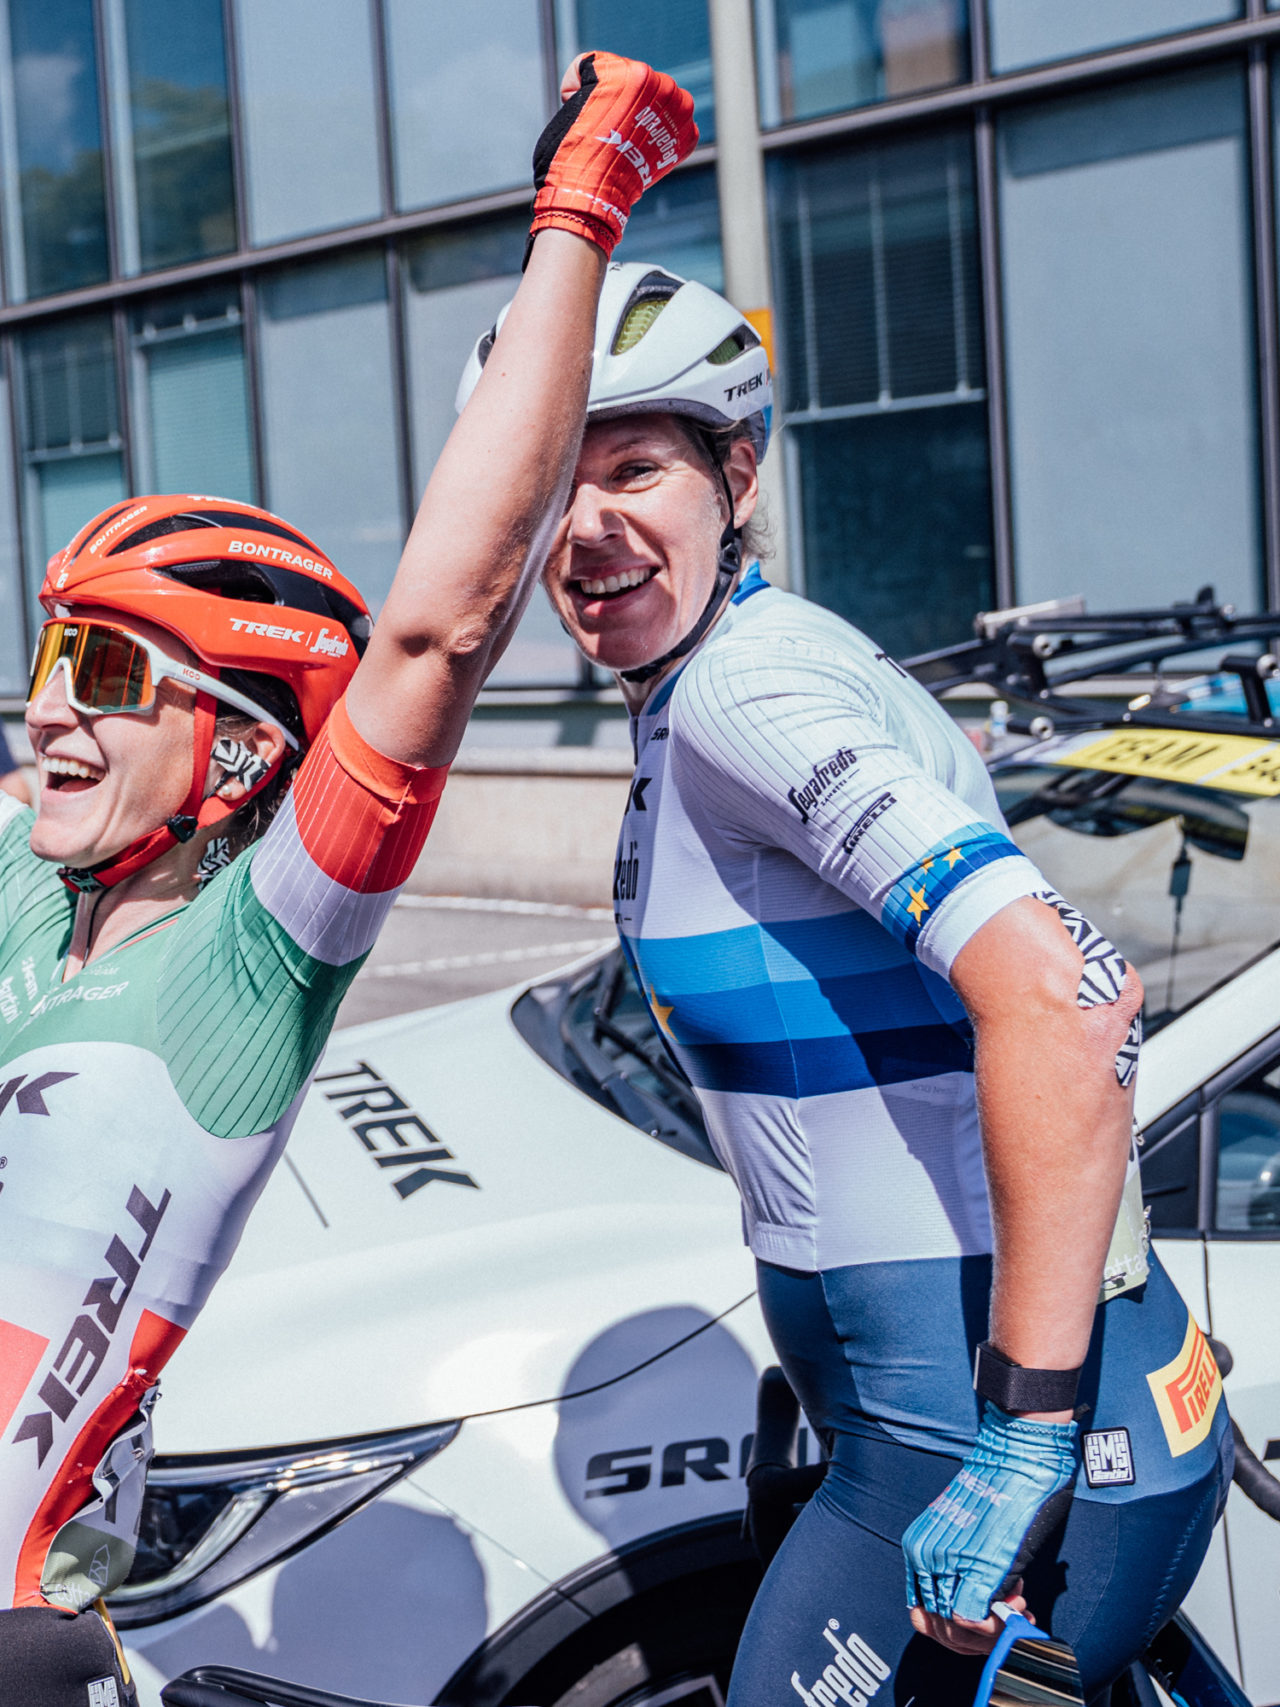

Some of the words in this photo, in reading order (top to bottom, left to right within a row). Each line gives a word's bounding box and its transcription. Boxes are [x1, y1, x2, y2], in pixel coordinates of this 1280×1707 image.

[594, 128, 652, 187] REK
[634, 106, 678, 170] Segafredo
[723, 372, 762, 402] TREK
[228, 541, 333, 580] BONTRAGER
[230, 618, 305, 643] TREK
[313, 1061, 480, 1199] TREK
[12, 1184, 172, 1470] TREK
[584, 1427, 816, 1499] SR
